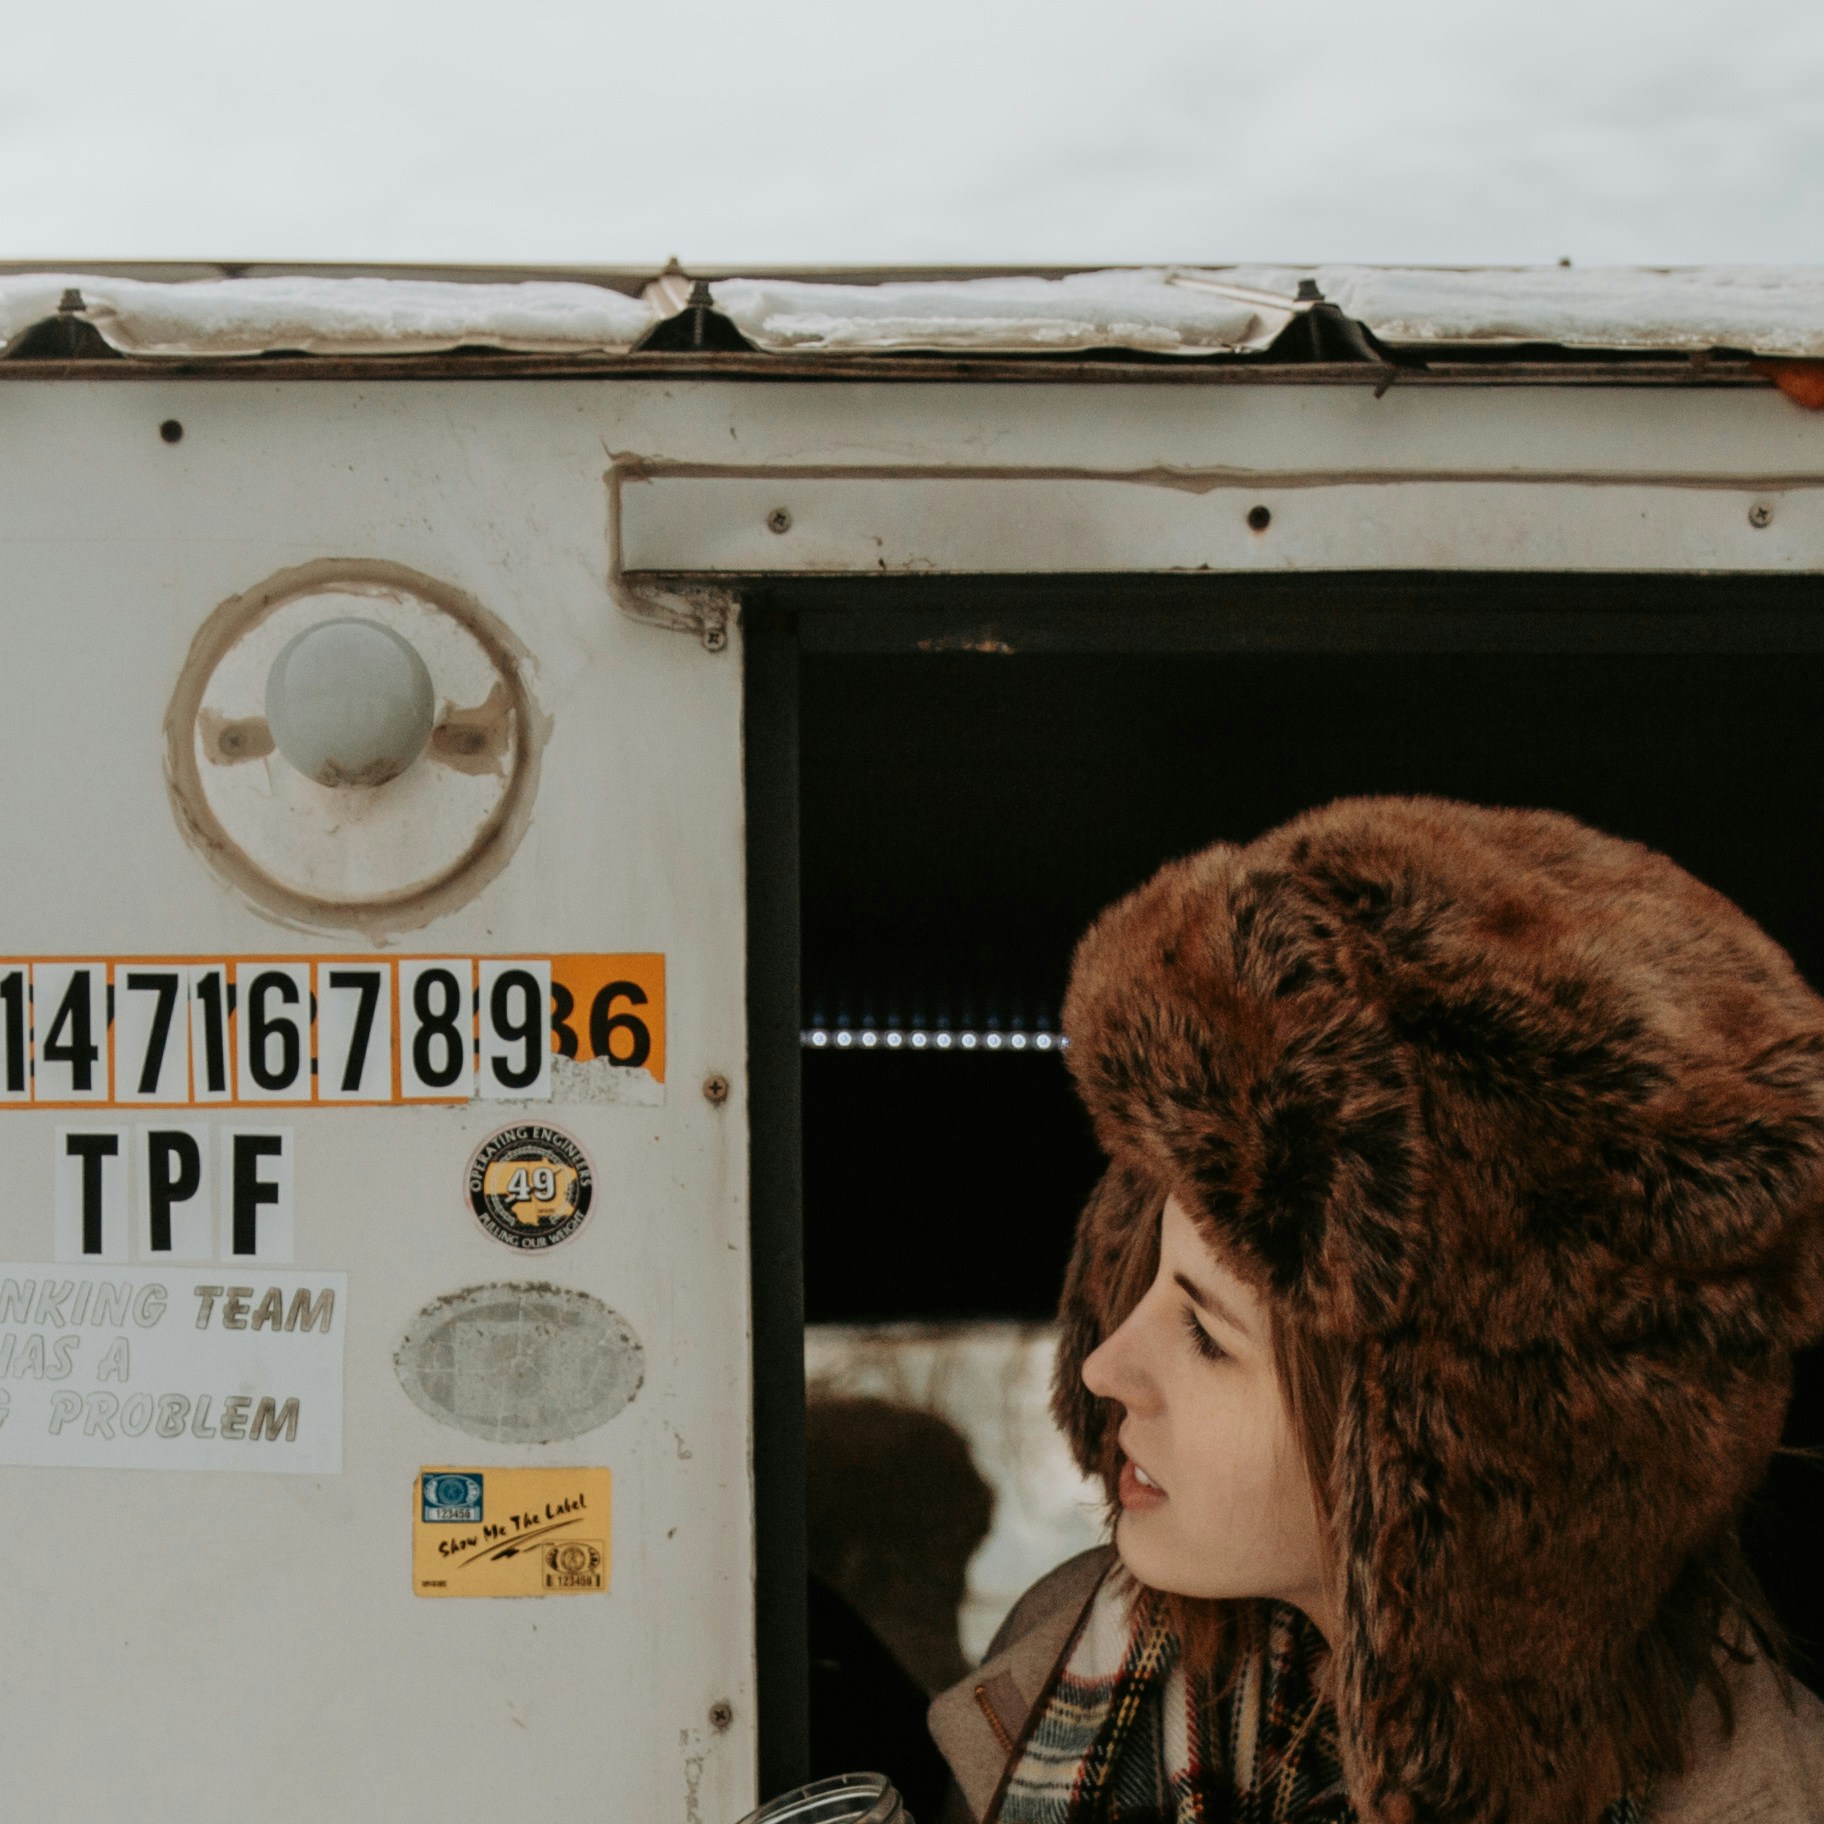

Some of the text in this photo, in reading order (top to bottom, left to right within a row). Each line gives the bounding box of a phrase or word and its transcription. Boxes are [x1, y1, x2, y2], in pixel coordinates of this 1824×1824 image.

[470, 1127, 593, 1193] OPERATING ENGINEERS
[507, 1167, 556, 1202] 49
[66, 1132, 282, 1256] TPF
[478, 1209, 585, 1249] PULLING OUR WEIGHT
[191, 1284, 336, 1334] TEAM
[96, 1335, 131, 1383] A
[47, 1390, 302, 1442] PROBLEM
[438, 1493, 588, 1558] Show Me The Label
